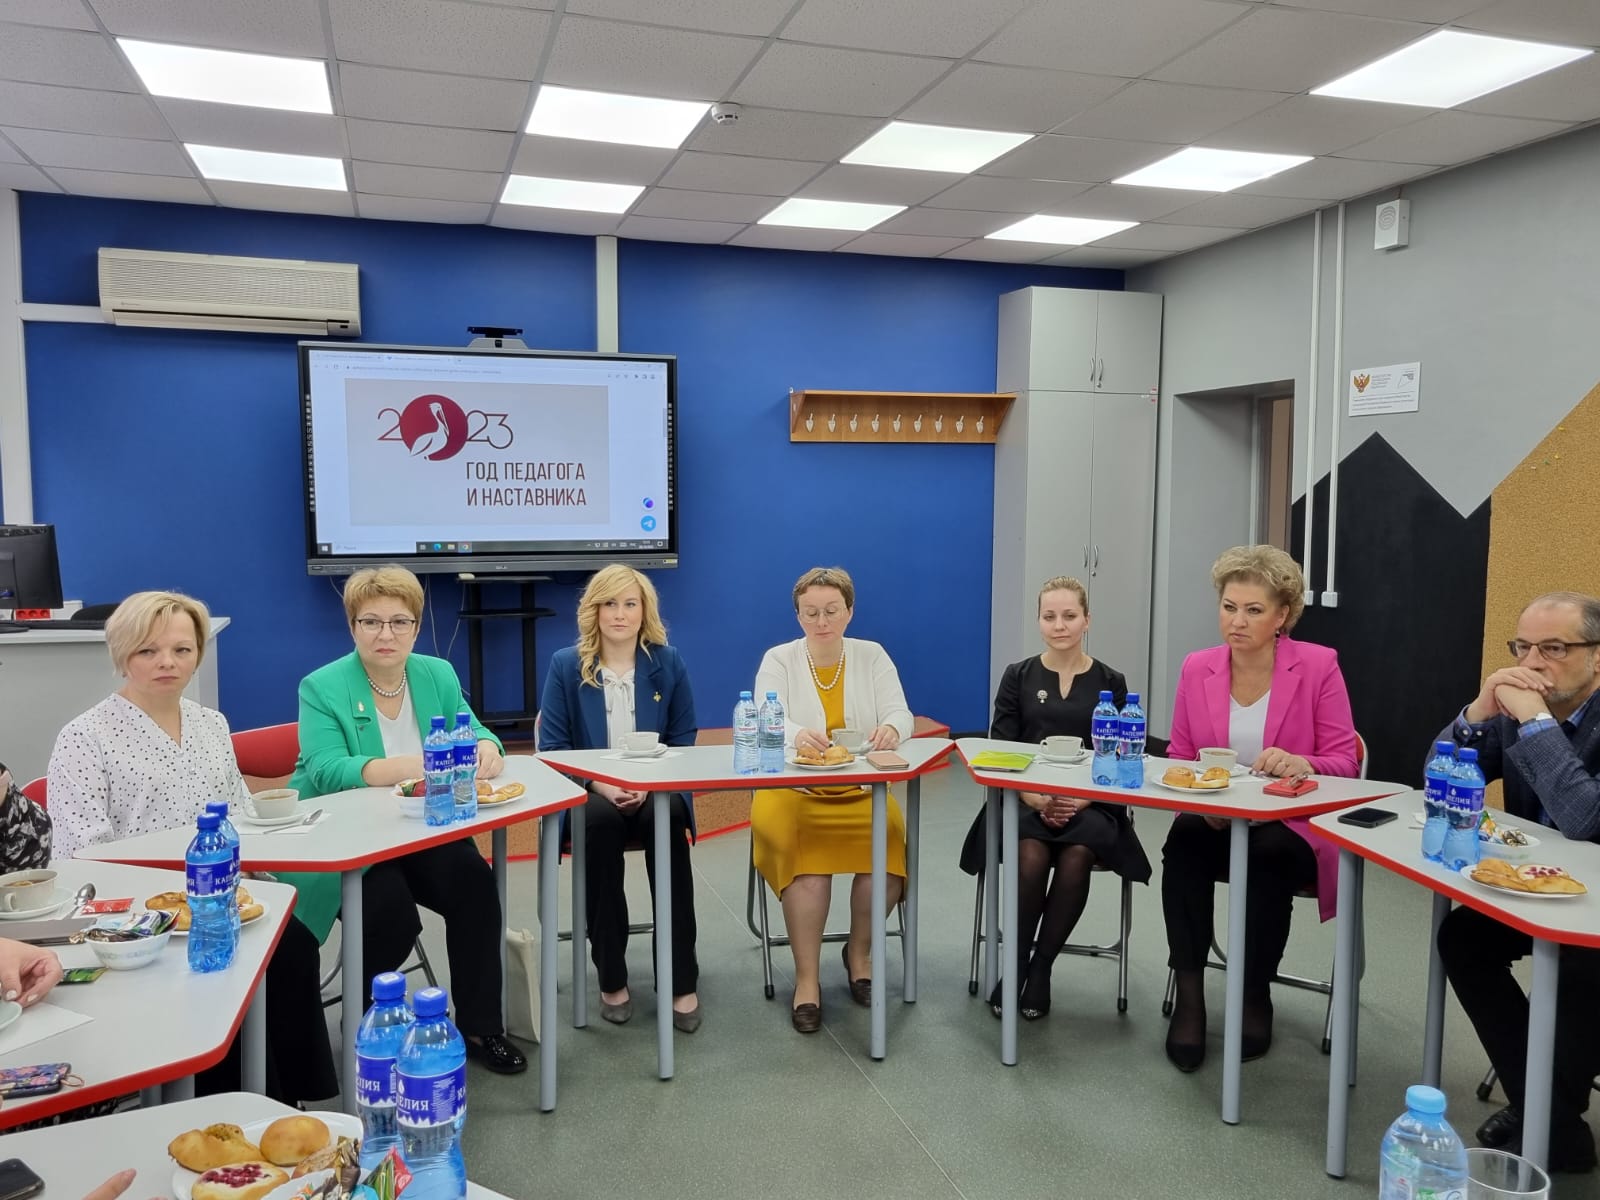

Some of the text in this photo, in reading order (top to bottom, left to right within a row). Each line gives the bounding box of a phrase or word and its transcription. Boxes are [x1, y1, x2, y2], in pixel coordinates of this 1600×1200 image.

[466, 461, 586, 482] ГОД ПЕДАГОГА
[466, 488, 587, 506] И НАСТАВНИКА
